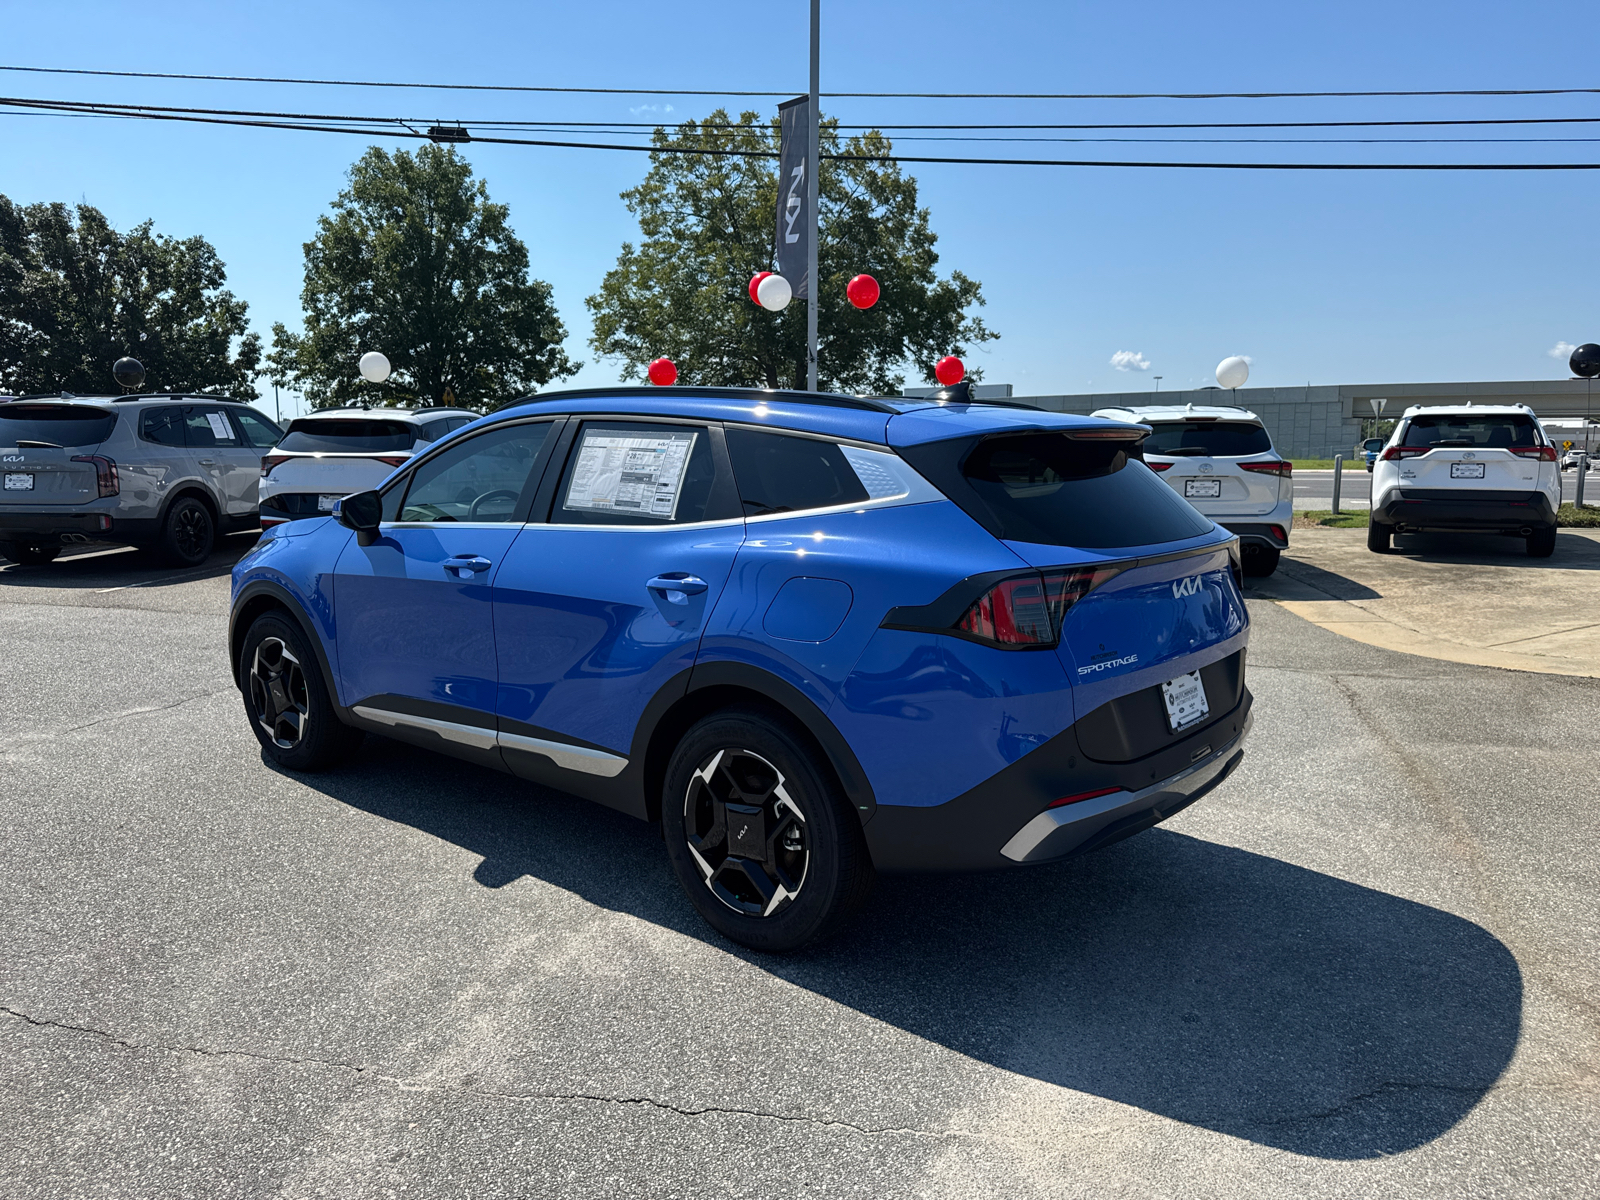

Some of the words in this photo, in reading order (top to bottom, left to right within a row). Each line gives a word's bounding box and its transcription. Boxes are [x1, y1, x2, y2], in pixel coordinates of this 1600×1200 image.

[785, 165, 803, 244] KIA
[3, 455, 25, 463] KIA
[1172, 574, 1203, 599] KIA
[1077, 653, 1139, 676] SPORTAGE
[737, 824, 749, 840] KIA
